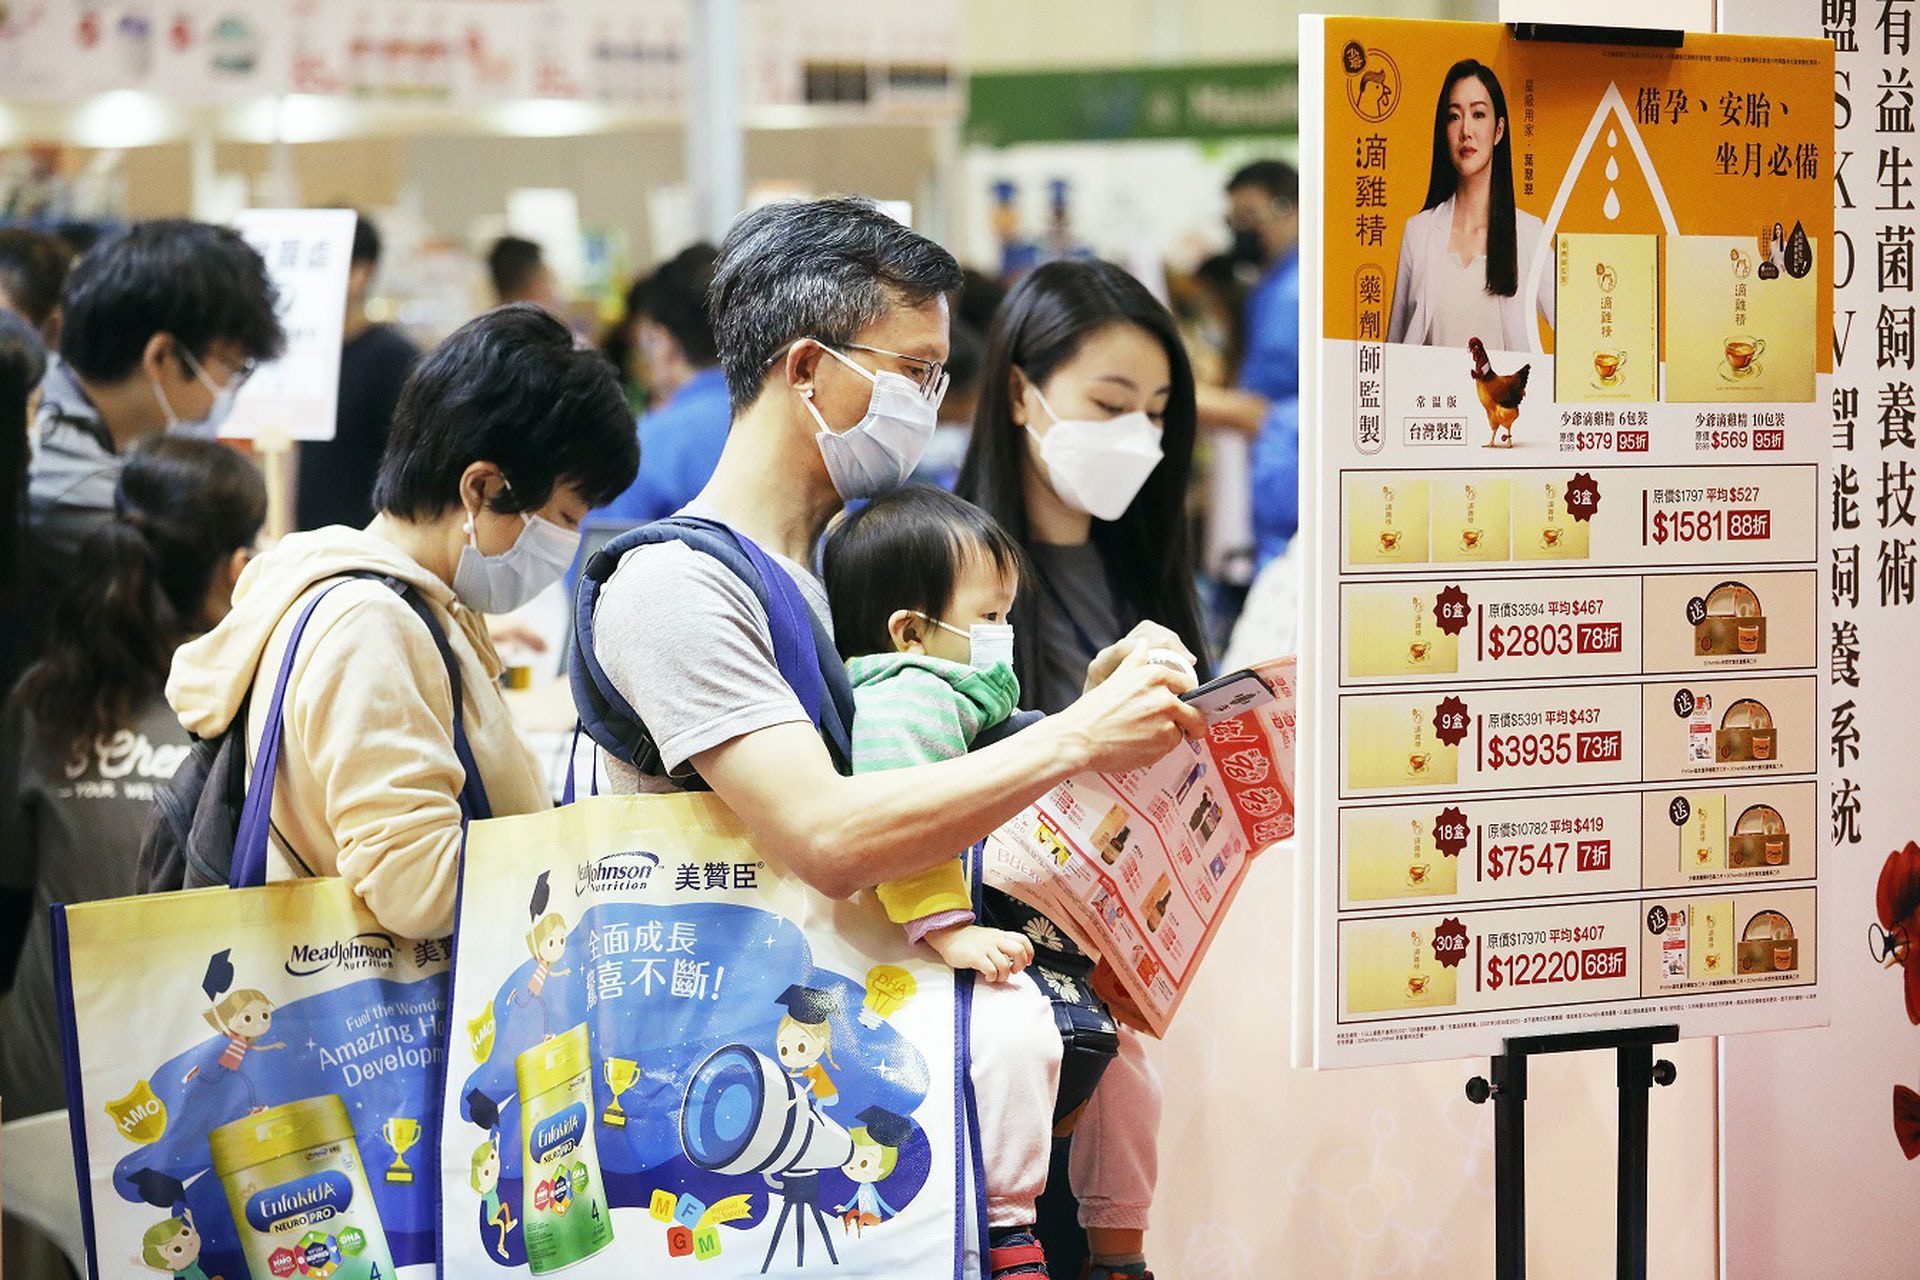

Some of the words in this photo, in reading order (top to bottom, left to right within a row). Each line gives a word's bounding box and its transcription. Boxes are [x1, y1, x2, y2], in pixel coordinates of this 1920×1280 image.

[1714, 142, 1819, 180] 坐月必備
[1355, 132, 1388, 247] 滴雞精
[1875, 0, 1918, 607] 有益生菌飼養技術
[1359, 275, 1381, 444] 藥劑師監製
[1619, 411, 1648, 426] 6包裝
[1753, 412, 1785, 427] 10包裝
[1409, 422, 1463, 441] 台灣製造
[1576, 431, 1613, 452] $379
[1618, 434, 1647, 450] 95折
[1711, 430, 1748, 451] $569
[1755, 431, 1784, 448] 95折
[1573, 489, 1593, 506] 3盒
[1652, 510, 1722, 545] $1581
[1730, 513, 1768, 537] 88折
[1442, 602, 1465, 619] 6盒
[1690, 600, 1706, 623] 送
[1488, 623, 1573, 661] $2803
[1581, 627, 1619, 650] 78折
[1677, 692, 1694, 714] 送
[1442, 712, 1464, 730] 9盒
[1487, 733, 1572, 771] $3935
[1580, 735, 1618, 758] 73折
[1672, 799, 1689, 823] 送
[1438, 823, 1465, 841] 18盒
[1486, 842, 1569, 881] $7547
[1580, 845, 1608, 868] 7折
[1651, 909, 1667, 931] 送
[588, 920, 698, 962] 全面成長
[1436, 934, 1465, 951] 30盒
[343, 958, 394, 972] Nutrition
[1486, 950, 1580, 991] $12220
[1584, 950, 1624, 976] 68折
[346, 1009, 370, 1032] Fuel
[373, 1003, 395, 1019] the
[318, 1024, 415, 1070] Amazing
[119, 1099, 160, 1133] HMO
[275, 1216, 307, 1232] NEURO
[309, 1208, 331, 1223] PRO
